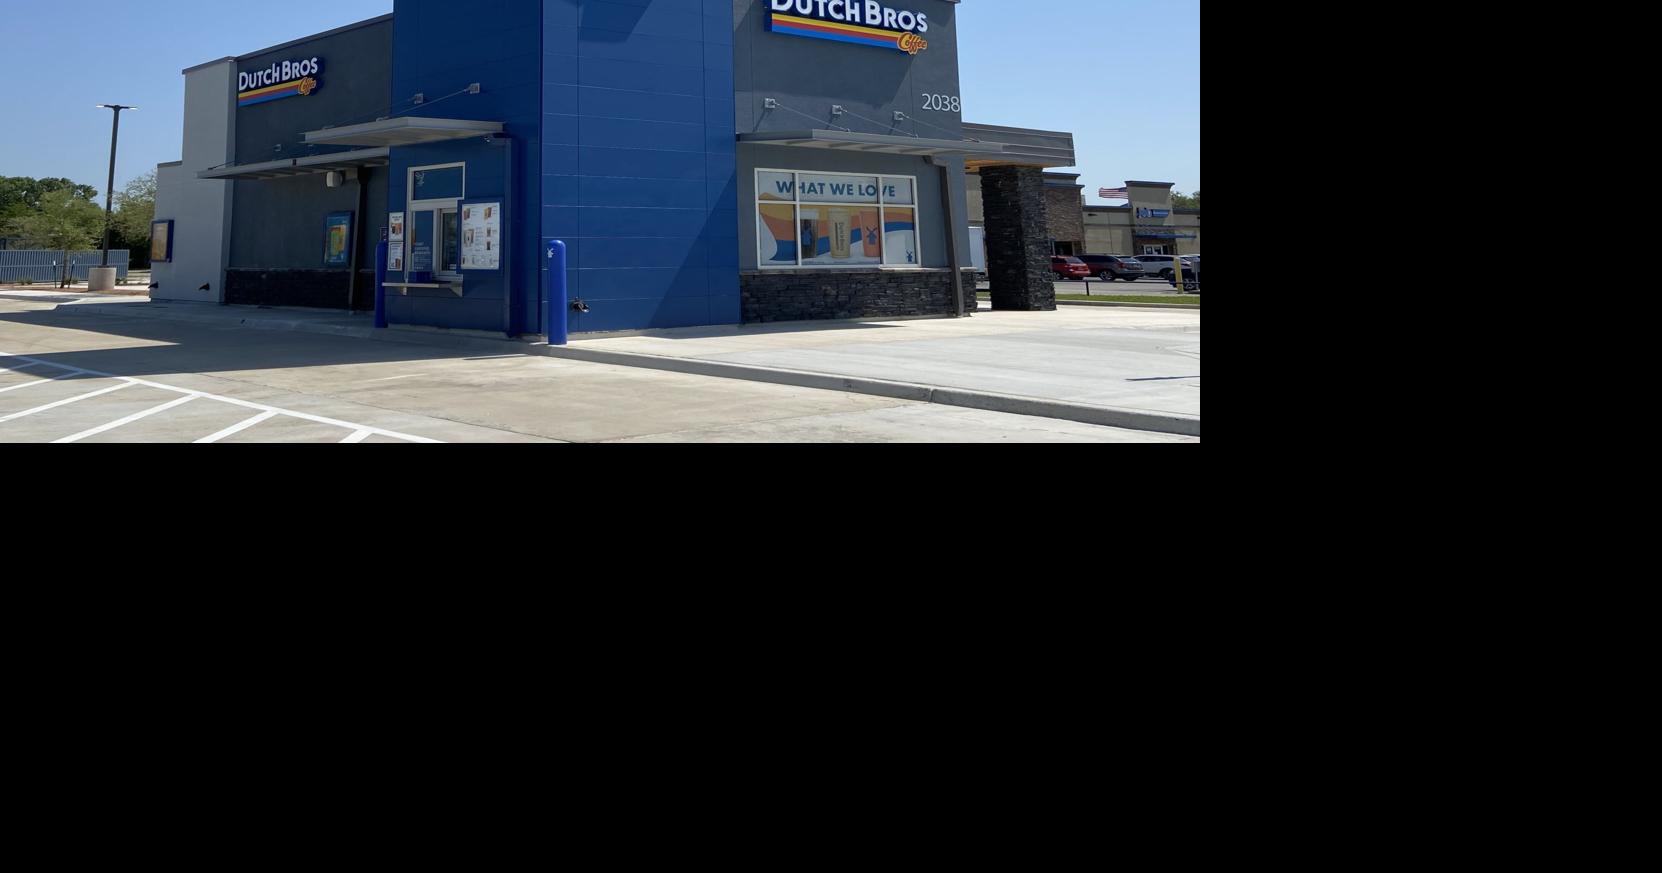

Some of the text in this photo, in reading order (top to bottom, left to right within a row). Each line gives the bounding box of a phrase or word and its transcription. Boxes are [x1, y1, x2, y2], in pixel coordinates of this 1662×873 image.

[865, 0, 928, 32] BROS
[899, 32, 927, 54] Coffee
[238, 62, 280, 91] DUTCH
[281, 57, 318, 81] BROS
[921, 93, 960, 113] 2038
[775, 180, 826, 195] WHAT
[829, 183, 854, 196] WE
